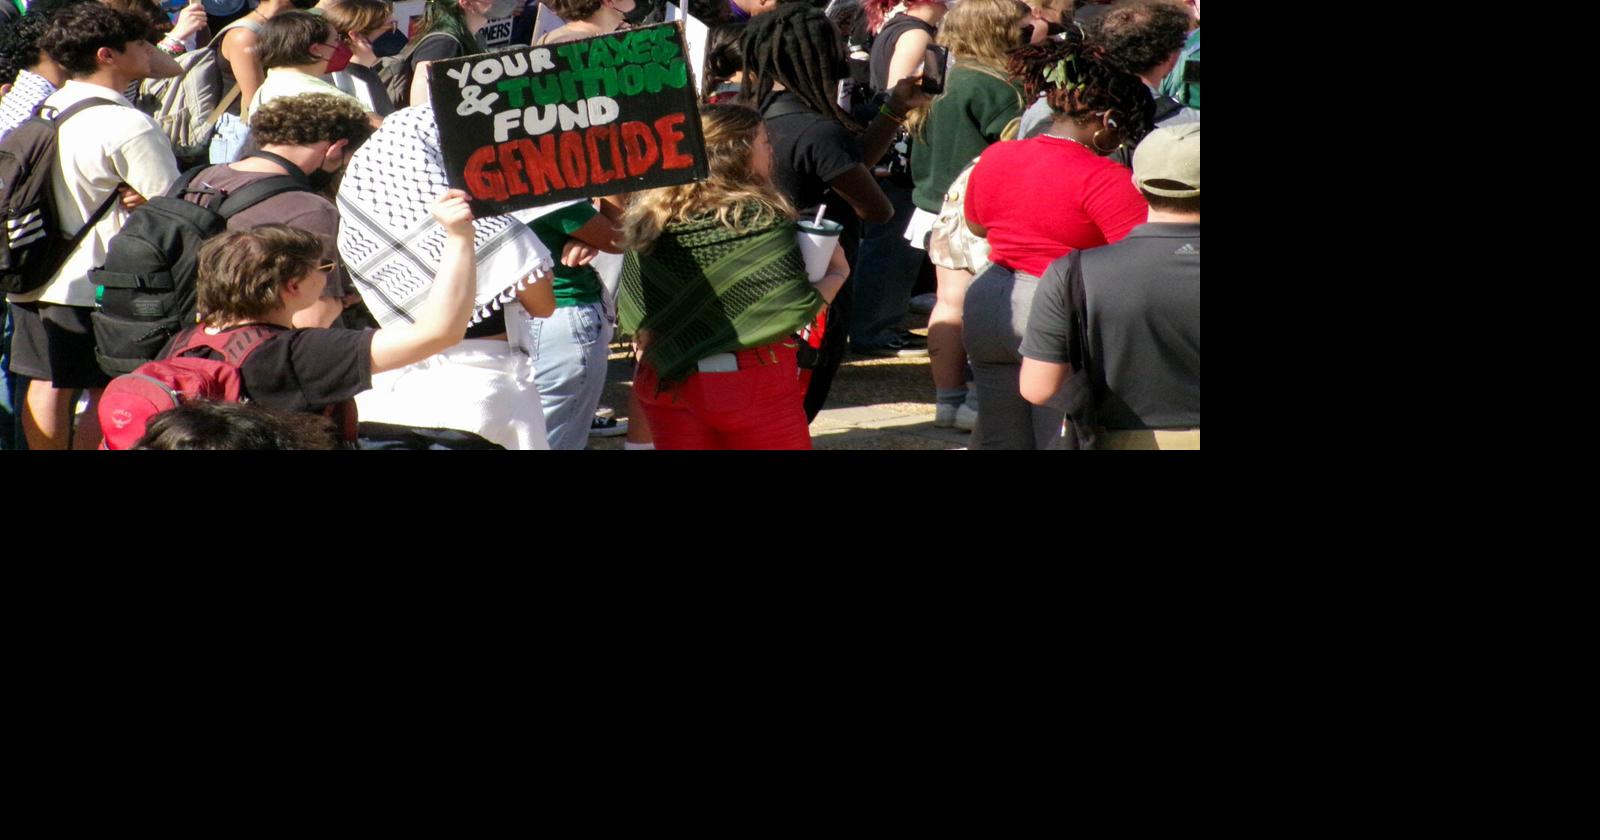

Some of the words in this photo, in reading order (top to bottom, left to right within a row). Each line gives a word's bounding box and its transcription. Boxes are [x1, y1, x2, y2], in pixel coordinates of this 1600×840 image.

[447, 49, 555, 88] YOUR
[557, 25, 678, 70] TAXES
[456, 85, 498, 116] &
[497, 58, 688, 108] TUITION
[493, 96, 620, 143] FUND
[463, 112, 694, 201] GENOCIDE
